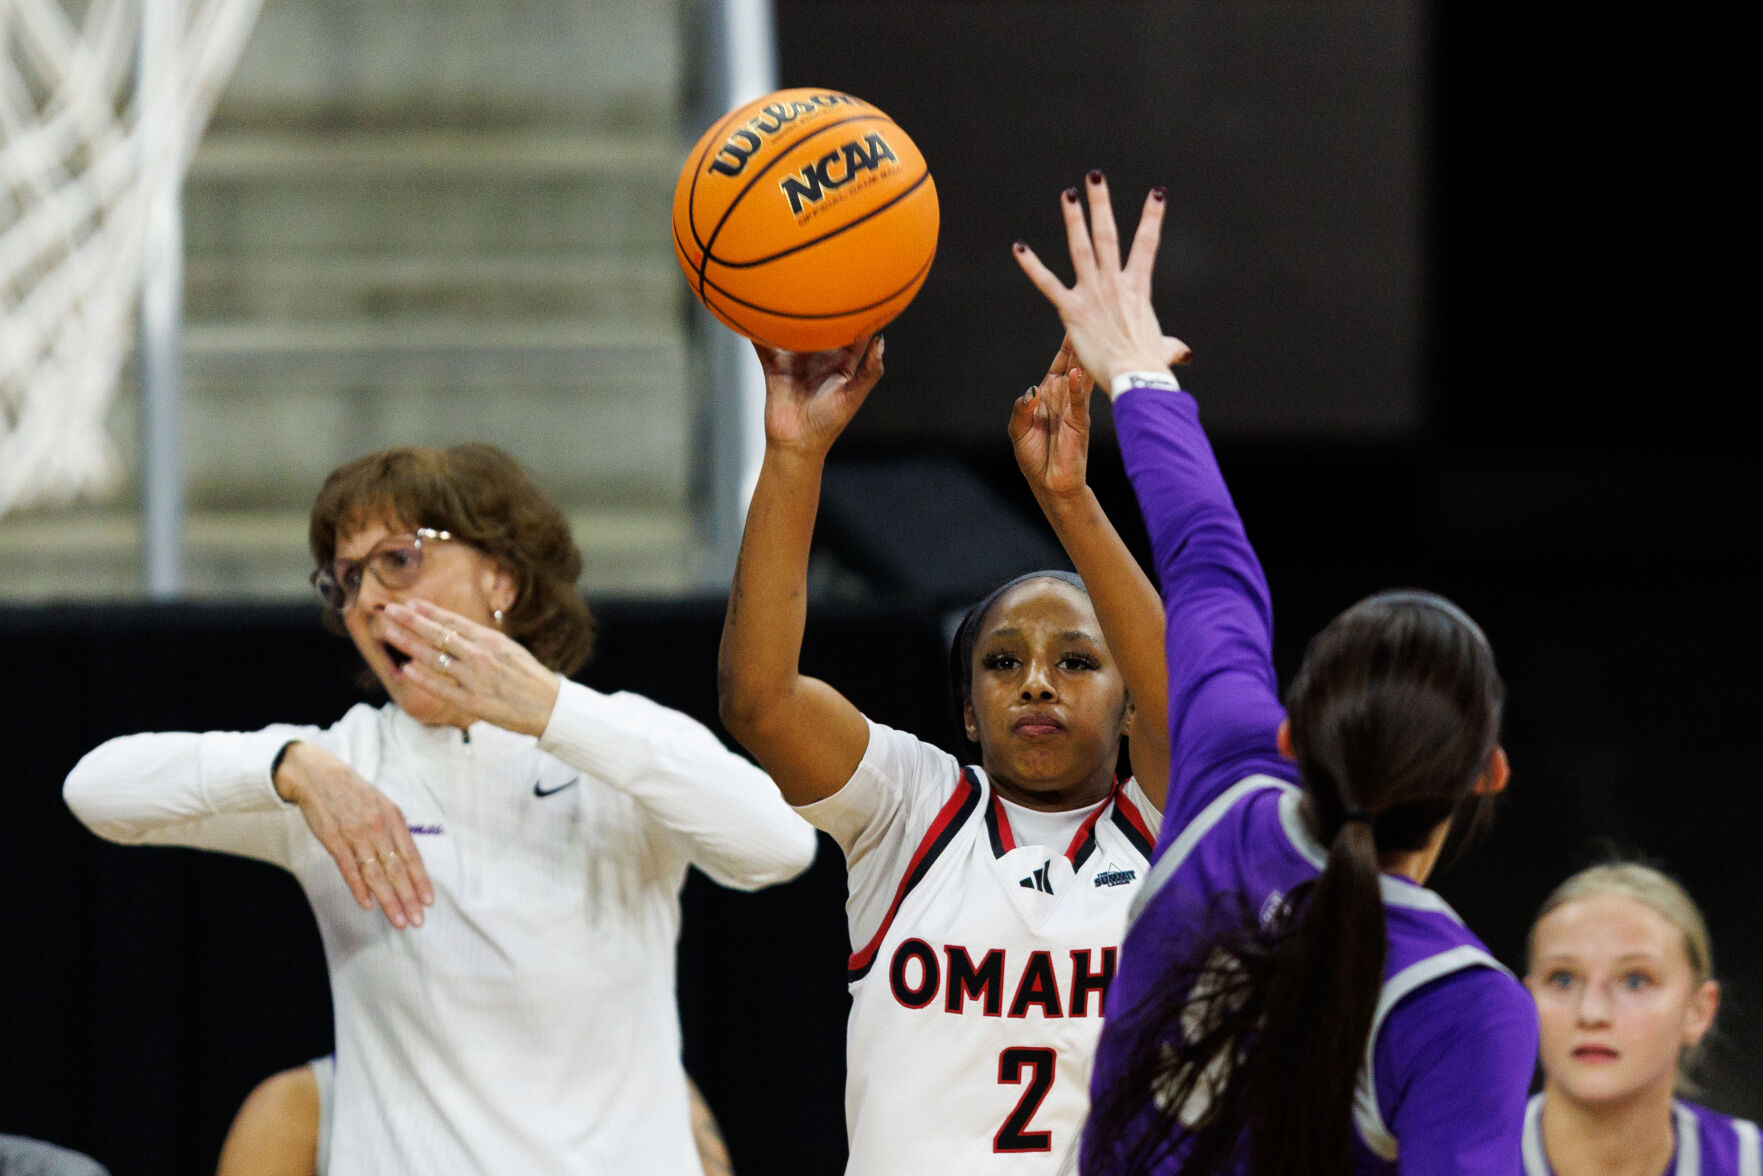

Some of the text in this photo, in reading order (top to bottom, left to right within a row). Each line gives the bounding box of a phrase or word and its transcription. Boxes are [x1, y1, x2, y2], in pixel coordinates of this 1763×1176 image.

[779, 131, 899, 218] NCAA
[1094, 870, 1136, 888] SUMMIT
[993, 1046, 1057, 1153] 2
